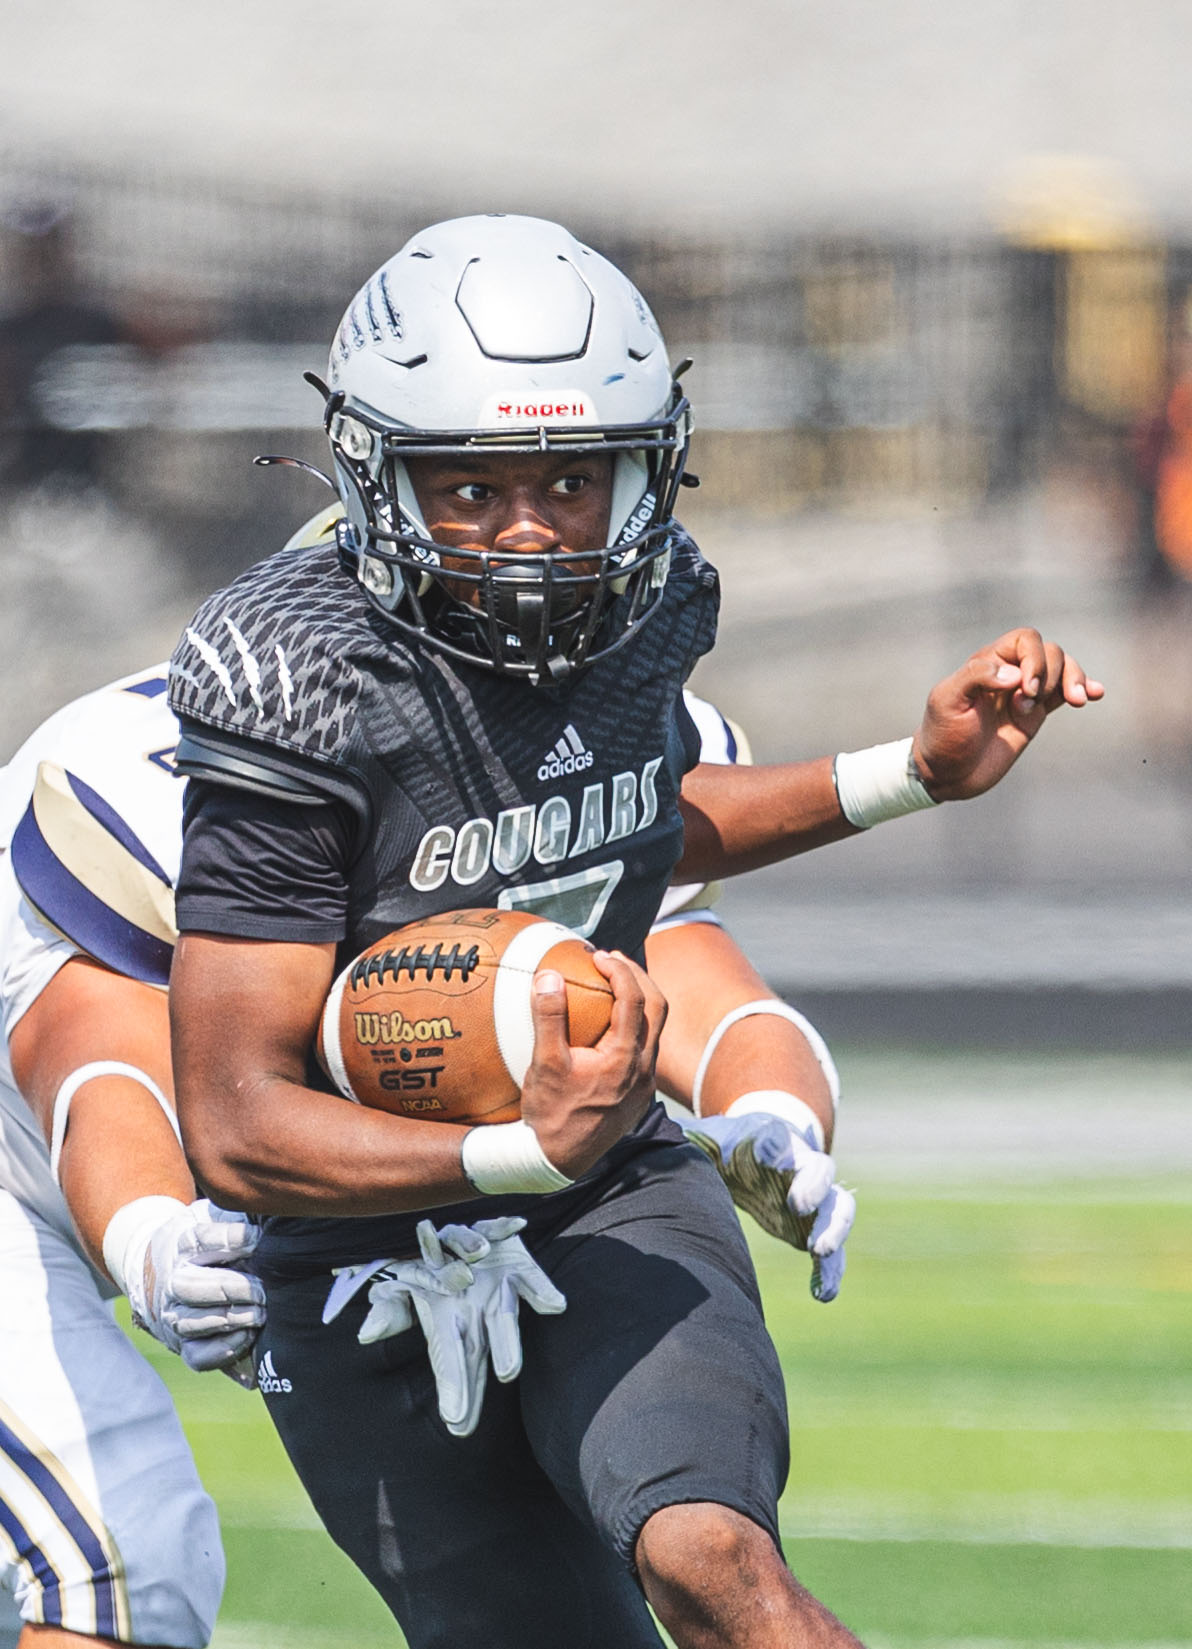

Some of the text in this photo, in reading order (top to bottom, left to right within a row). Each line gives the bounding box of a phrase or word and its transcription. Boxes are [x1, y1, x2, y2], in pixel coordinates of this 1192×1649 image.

[609, 492, 657, 564] ddell
[537, 750, 594, 781] adidas
[409, 755, 665, 892] COUGARS
[355, 1010, 458, 1045] Wilson
[378, 1065, 446, 1091] GST
[400, 1097, 444, 1113] NCAA
